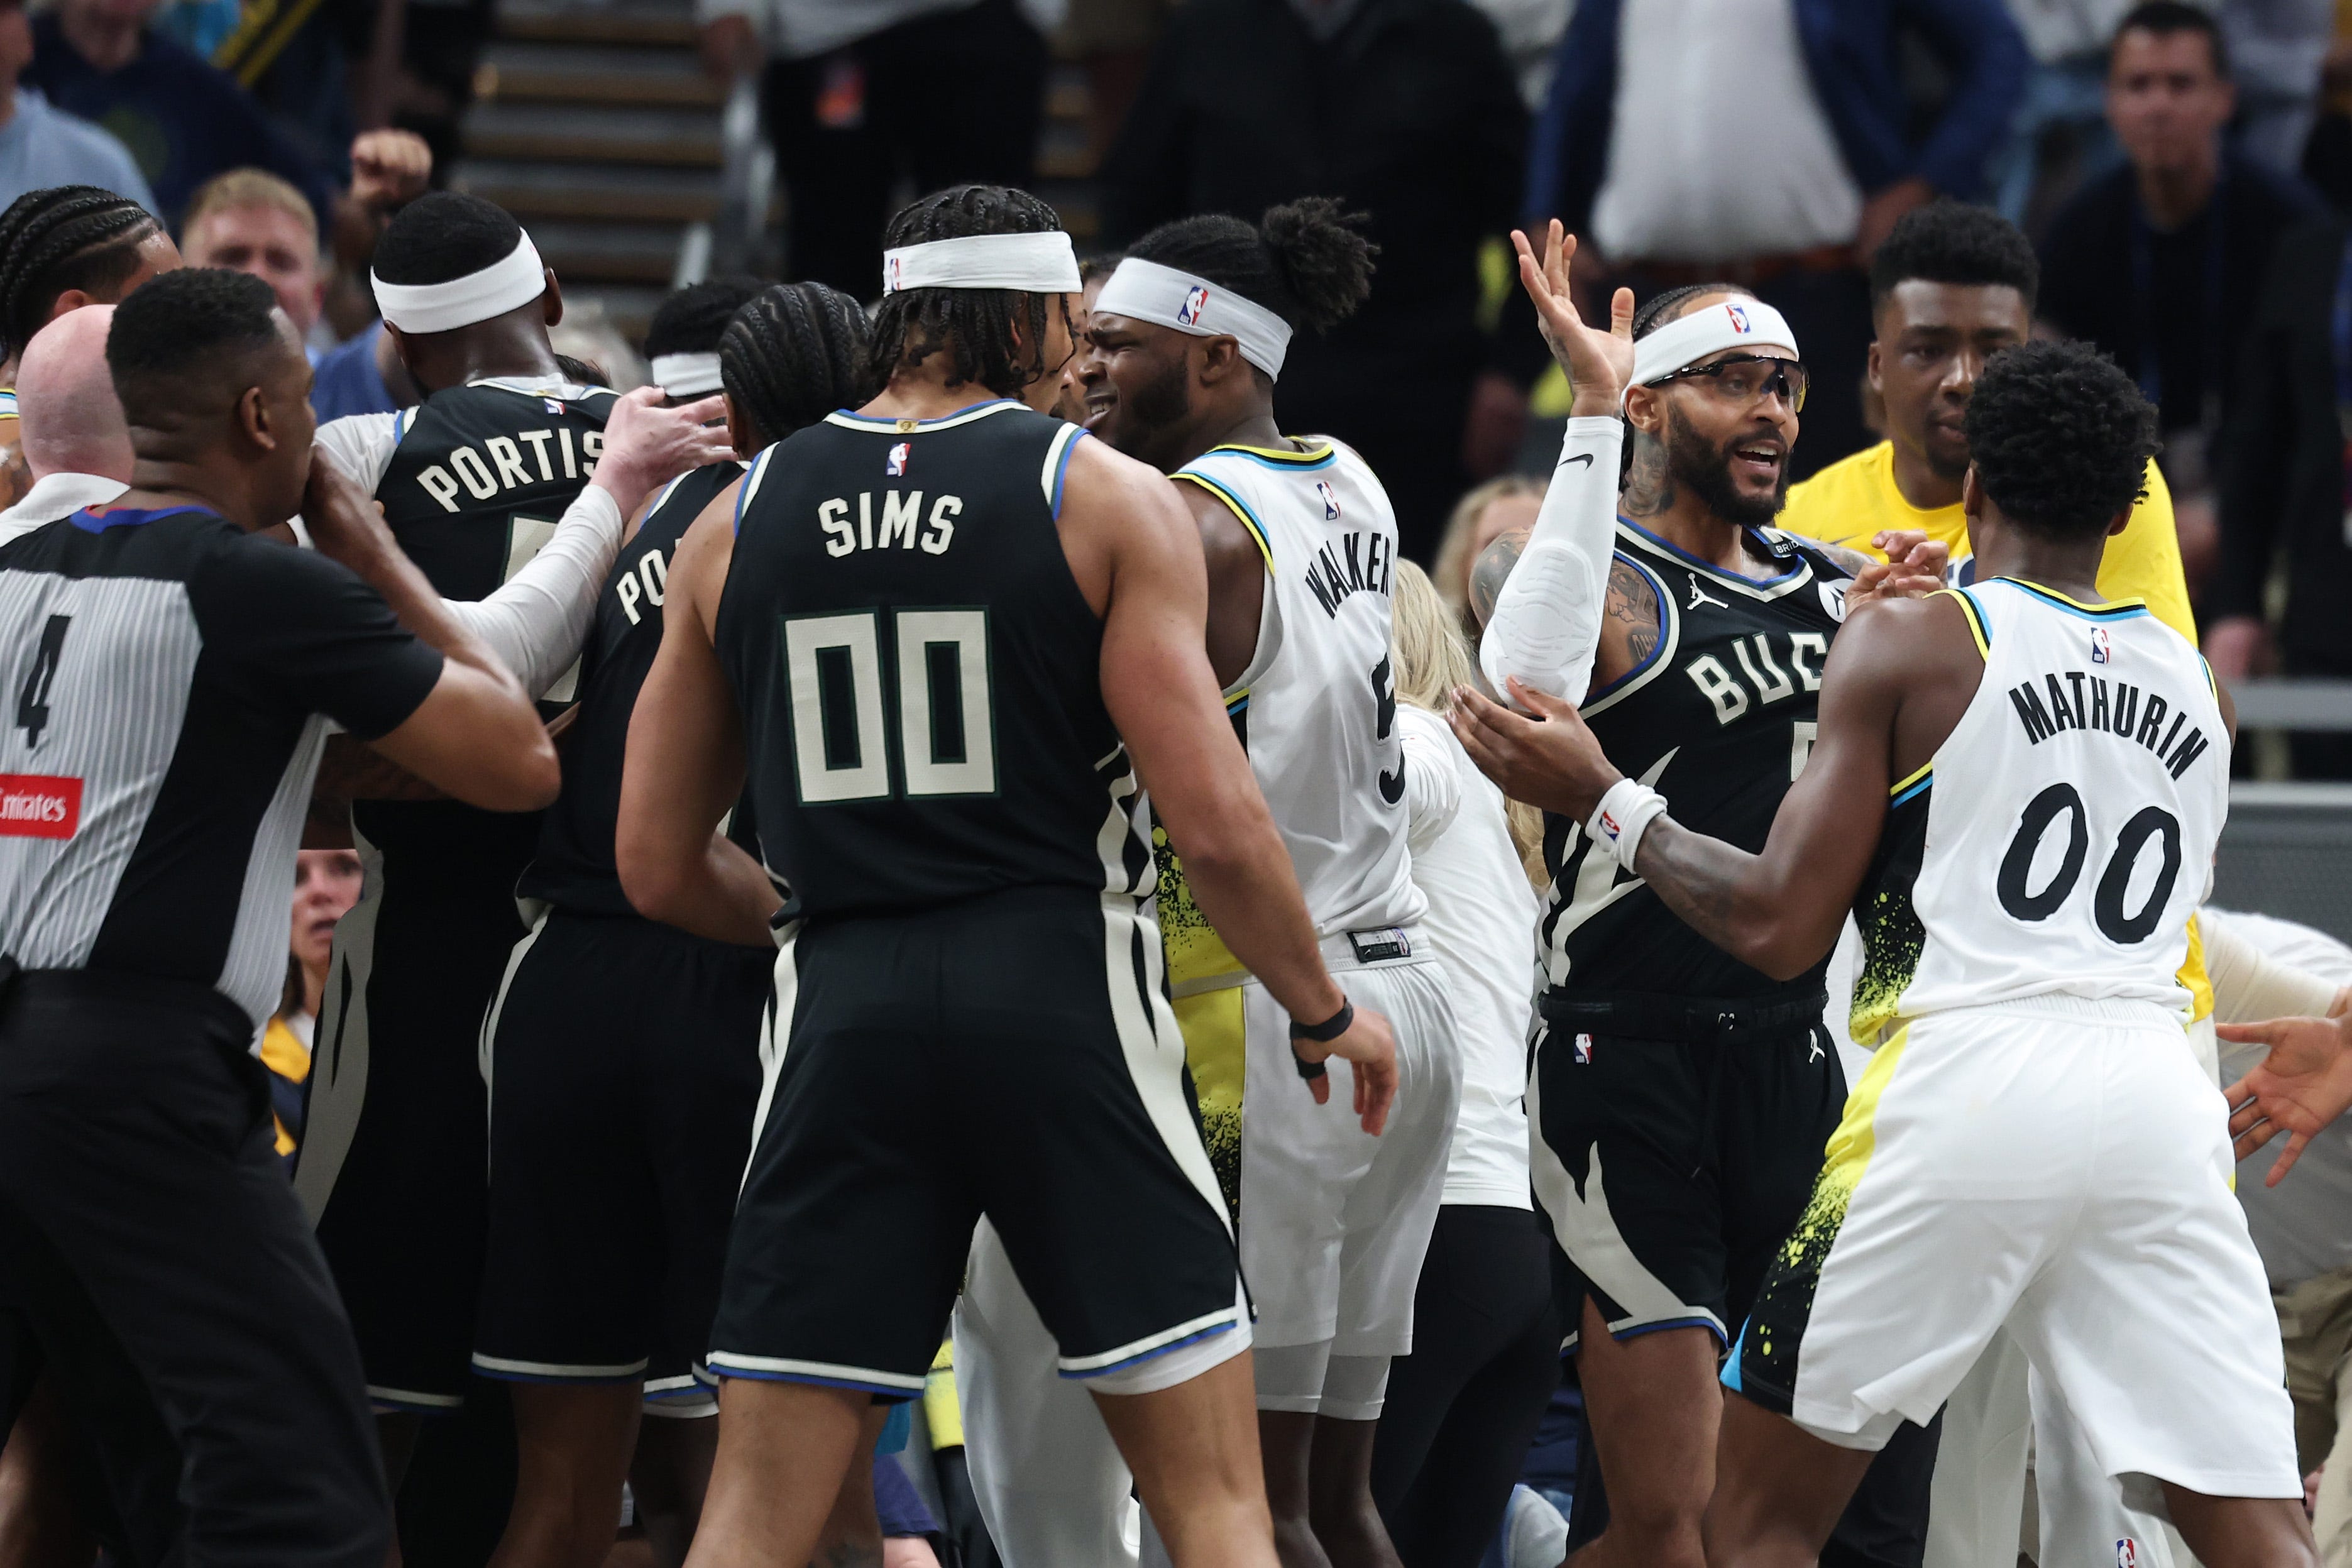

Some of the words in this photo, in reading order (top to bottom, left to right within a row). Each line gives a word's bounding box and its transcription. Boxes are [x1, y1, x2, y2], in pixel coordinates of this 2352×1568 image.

[818, 490, 963, 557] SIMS
[1775, 540, 1803, 554] BRID
[616, 538, 683, 625] PO
[1305, 532, 1390, 620] WALKER
[16, 615, 72, 749] 4
[783, 610, 996, 803] 00
[2009, 672, 2209, 781] MATHURIN
[0, 789, 67, 822] mirates
[1997, 782, 2182, 945] 00
